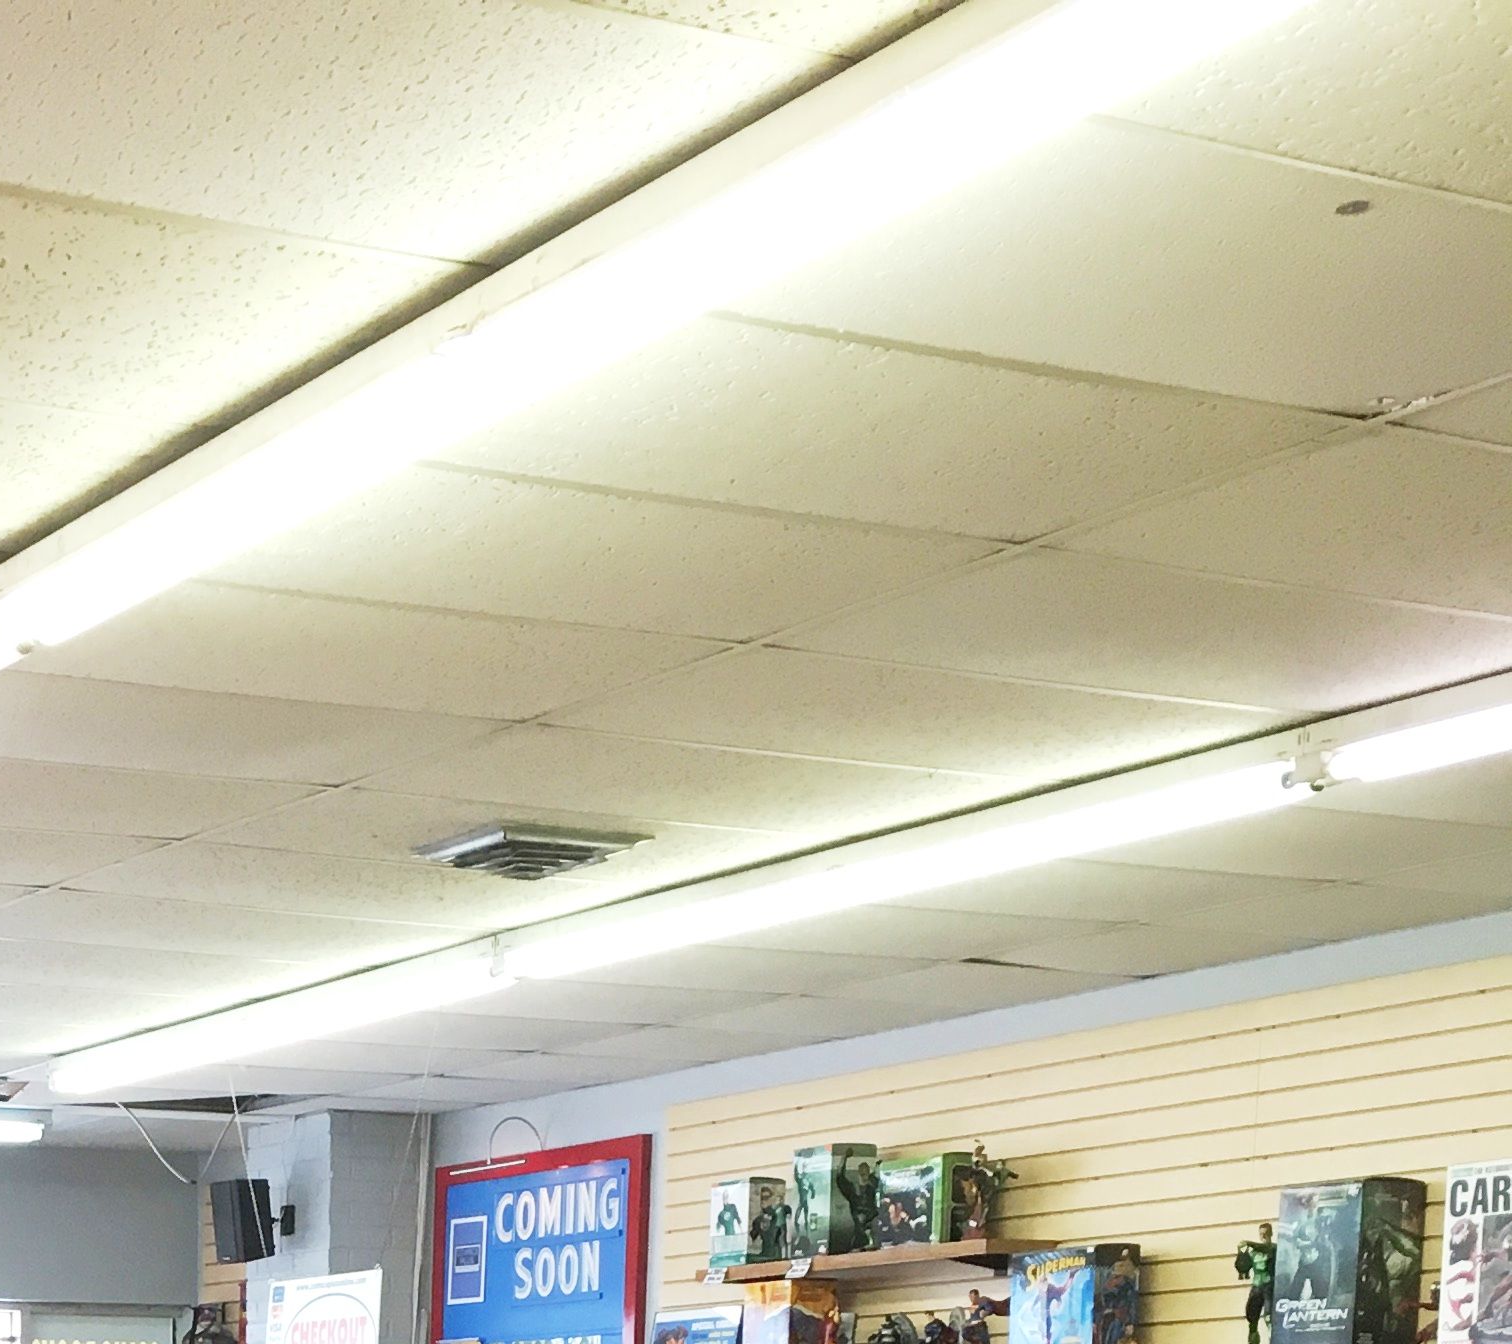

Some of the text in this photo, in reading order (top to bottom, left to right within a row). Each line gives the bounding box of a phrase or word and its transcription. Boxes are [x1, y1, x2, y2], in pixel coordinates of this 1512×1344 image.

[495, 1178, 619, 1243] COMING
[1450, 1175, 1512, 1217] CAR
[514, 1240, 600, 1299] SOON
[1026, 1256, 1086, 1292] SUPERMAN
[1276, 1298, 1327, 1313] GREEN
[1283, 1308, 1348, 1328] LANTERN
